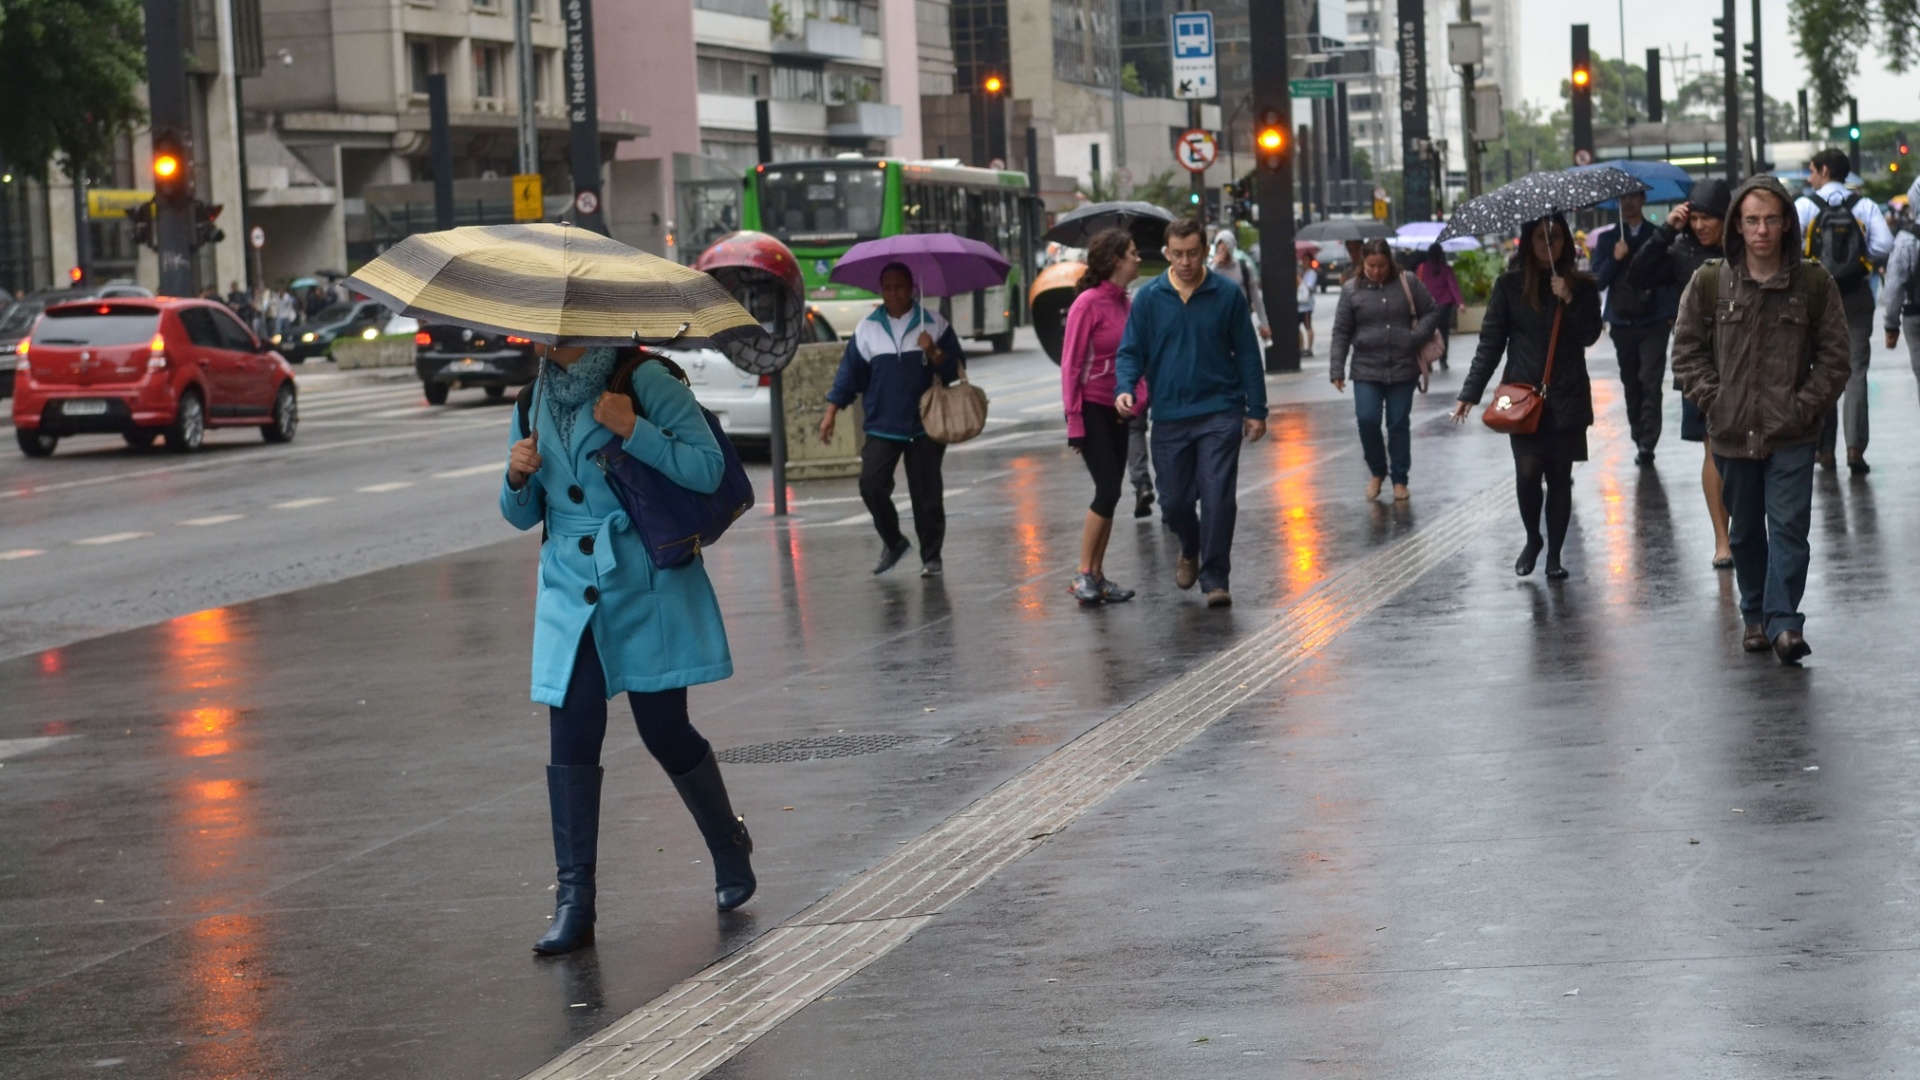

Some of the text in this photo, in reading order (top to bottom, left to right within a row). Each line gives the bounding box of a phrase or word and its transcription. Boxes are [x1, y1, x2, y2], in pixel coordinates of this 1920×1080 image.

[570, 33, 585, 104] Haddock
[1402, 21, 1419, 91] Augusta
[572, 105, 586, 122] R.
